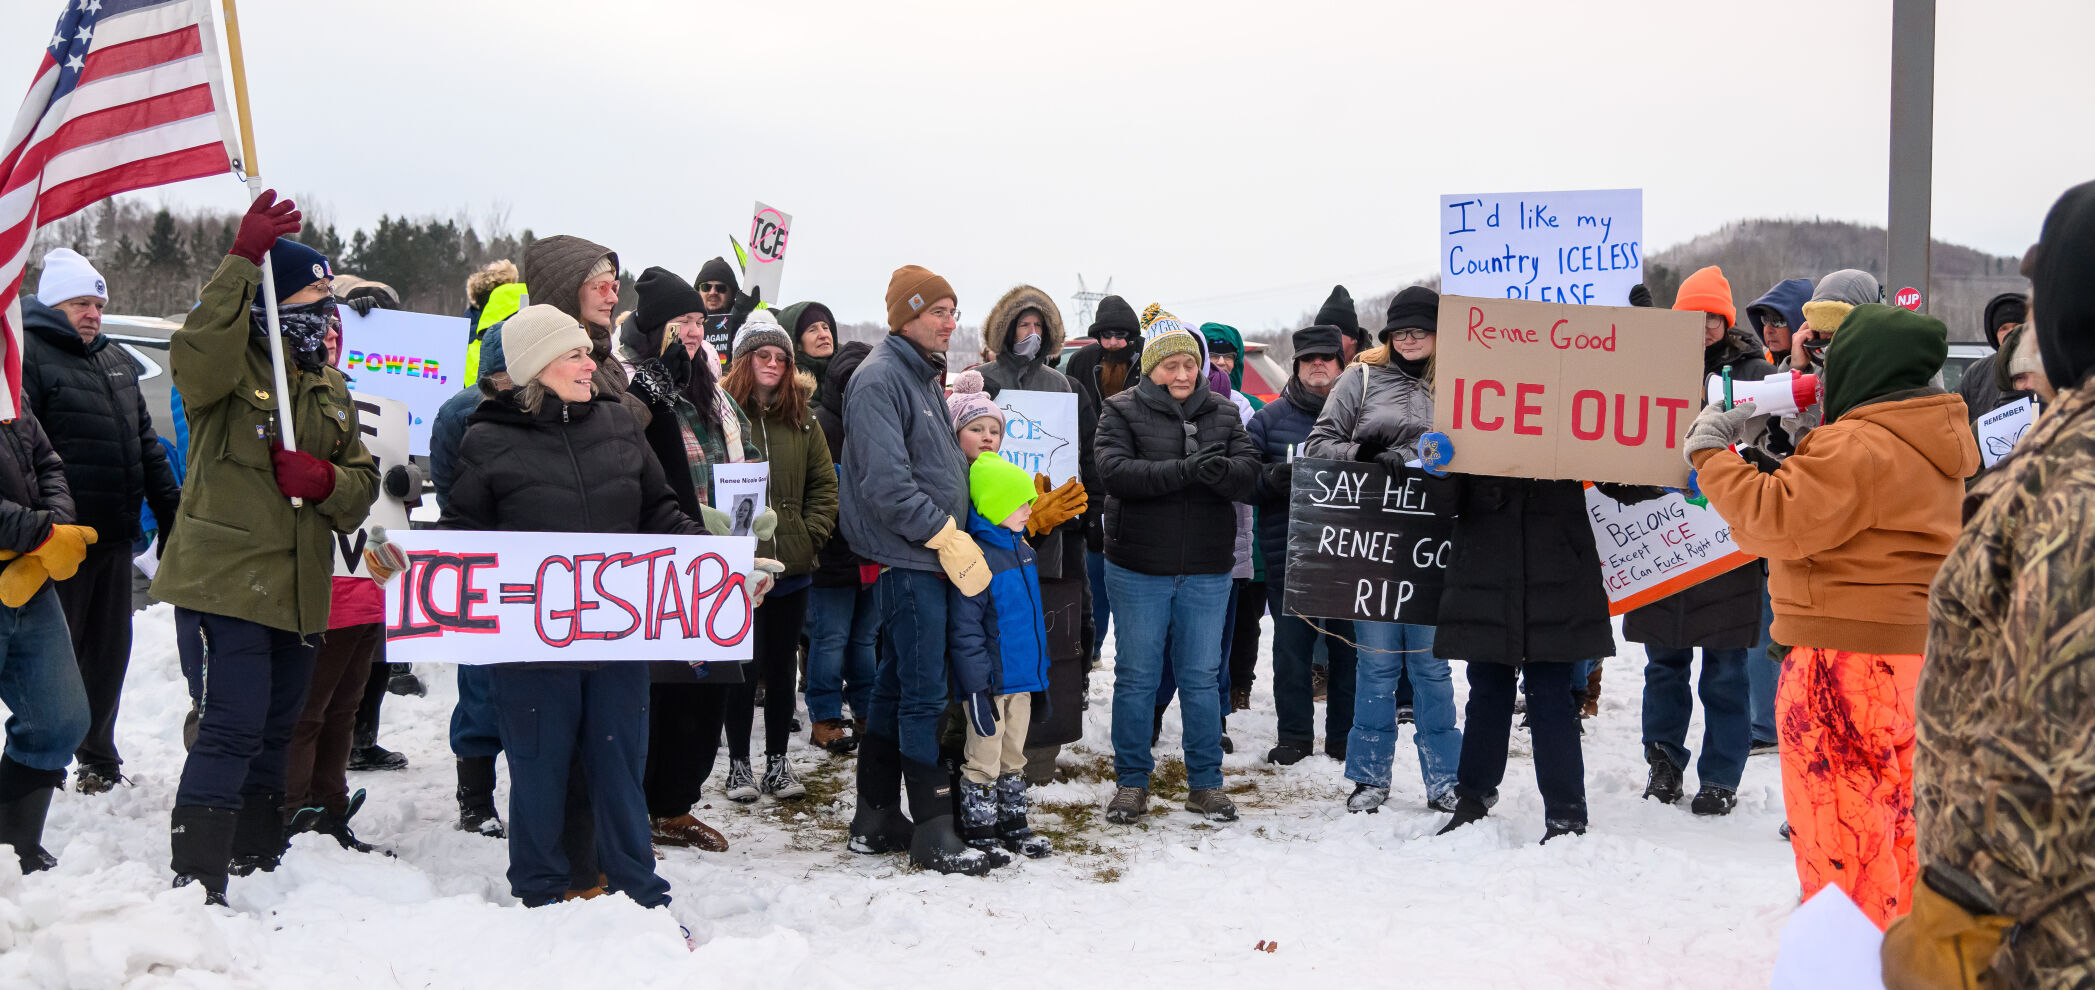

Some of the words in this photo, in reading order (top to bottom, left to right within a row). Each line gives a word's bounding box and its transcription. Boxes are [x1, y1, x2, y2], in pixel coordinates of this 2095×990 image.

[750, 216, 788, 260] ICE
[1449, 199, 1500, 235] I'd
[1577, 214, 1612, 244] my
[1450, 244, 1539, 285] Country
[1558, 241, 1639, 274] ICELESS
[1897, 293, 1920, 306] NJP
[1468, 306, 1539, 349] Renne
[1550, 319, 1616, 352] Good
[348, 350, 447, 385] POWER,
[1005, 419, 1042, 440] CE
[1453, 378, 1545, 436] ICE
[1571, 389, 1690, 449] OUT
[1983, 405, 2025, 427] REMEMBER
[1309, 470, 1369, 504] SAY
[1606, 501, 1686, 548] BELONG
[1608, 543, 1651, 569] Except
[1660, 522, 1696, 548] ICE
[1317, 525, 1400, 564] RENEE
[1412, 537, 1452, 569] GO
[1604, 569, 1631, 593] ICE
[1630, 565, 1653, 581] Can
[1653, 551, 1684, 572] Fuck
[1684, 539, 1712, 558] Right
[1354, 578, 1414, 620] RIP
